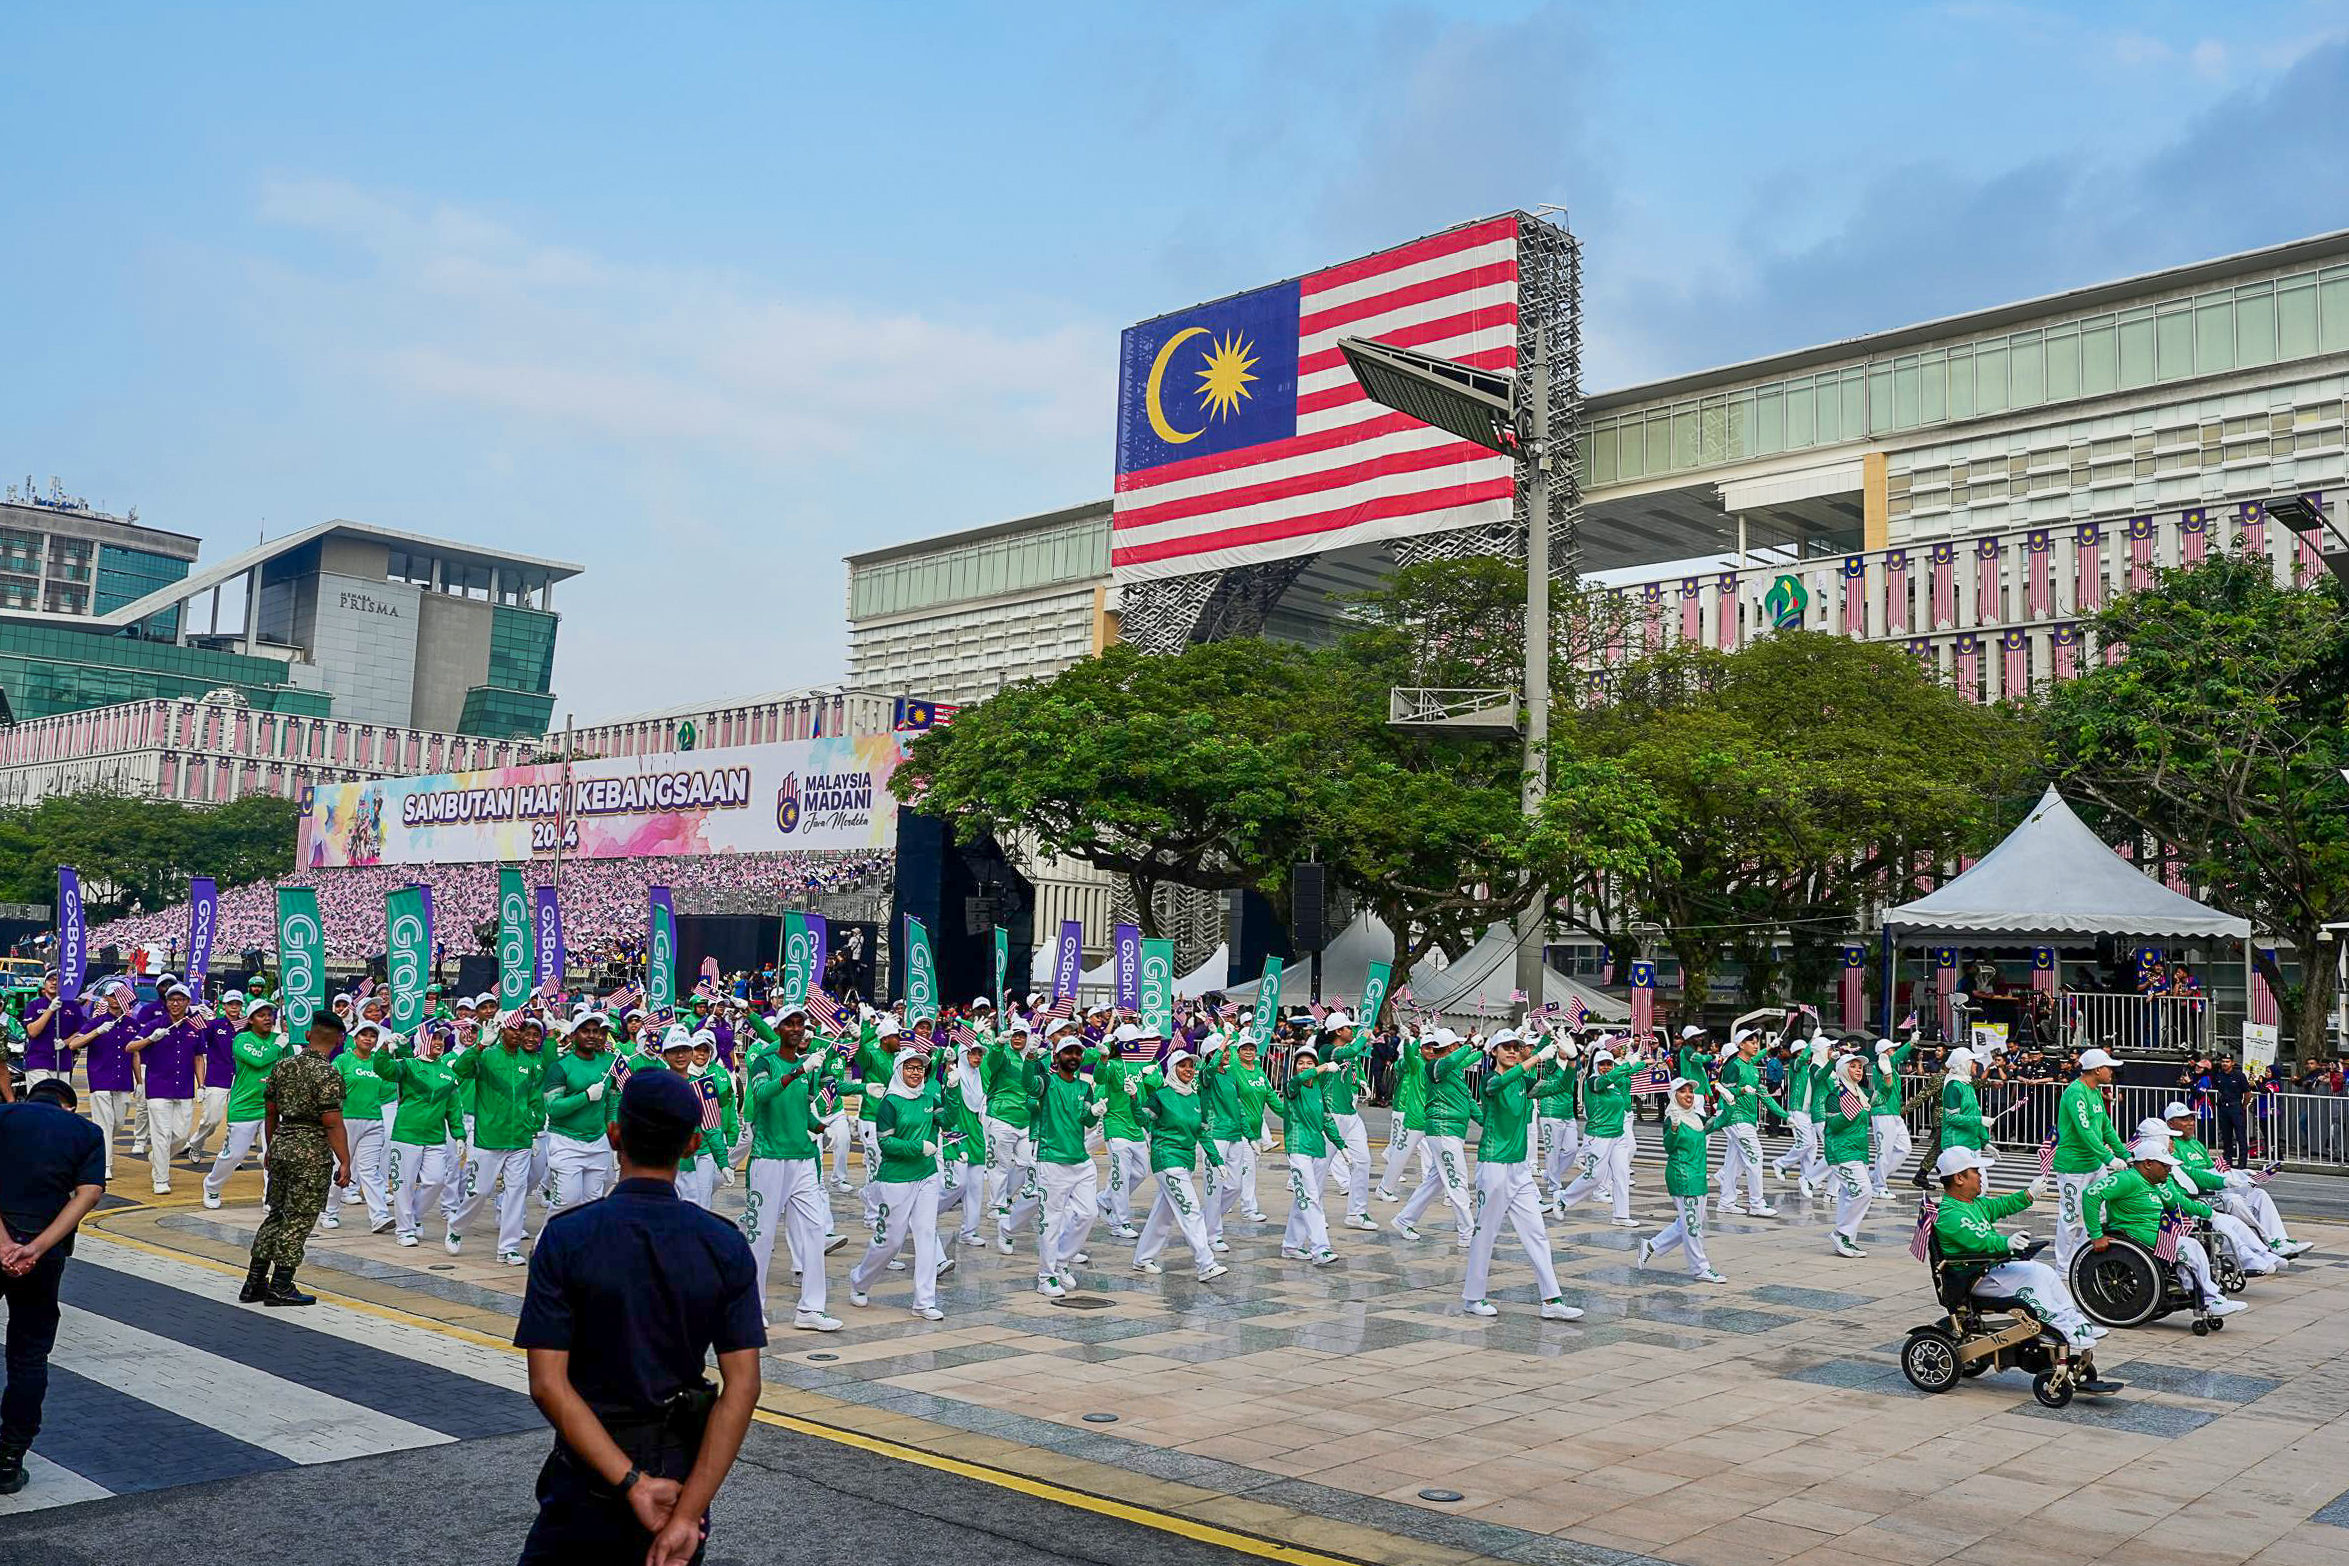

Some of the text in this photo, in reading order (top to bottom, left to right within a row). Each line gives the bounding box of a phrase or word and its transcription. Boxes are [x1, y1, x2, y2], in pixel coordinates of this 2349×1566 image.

[340, 597, 399, 617] PRISMA
[341, 592, 371, 601] MENARA
[403, 769, 750, 825] SAMBUTAN HARI KEBANGSAAN
[804, 789, 872, 811] MADANI
[805, 772, 872, 791] MALAYSIA
[63, 889, 79, 986] GXBank
[502, 892, 529, 997] Grab
[283, 913, 321, 1026] Grab
[392, 914, 423, 1021] Grab
[1122, 939, 1135, 1001] GXBank
[1143, 956, 1169, 1029] Grab
[1253, 973, 1278, 1044] Grab
[2077, 1100, 2090, 1129] Grab
[986, 1134, 998, 1170] Grab
[1543, 1123, 1552, 1154] Grab
[1112, 1152, 1121, 1191] Grab
[1290, 1167, 1312, 1211] Grab
[1441, 1150, 1460, 1189] Grab
[2087, 1175, 2118, 1195] Grab
[1166, 1174, 1191, 1215] Grab
[2063, 1182, 2079, 1223] Grab
[746, 1190, 763, 1244] Grab
[1683, 1195, 1700, 1237] Grab
